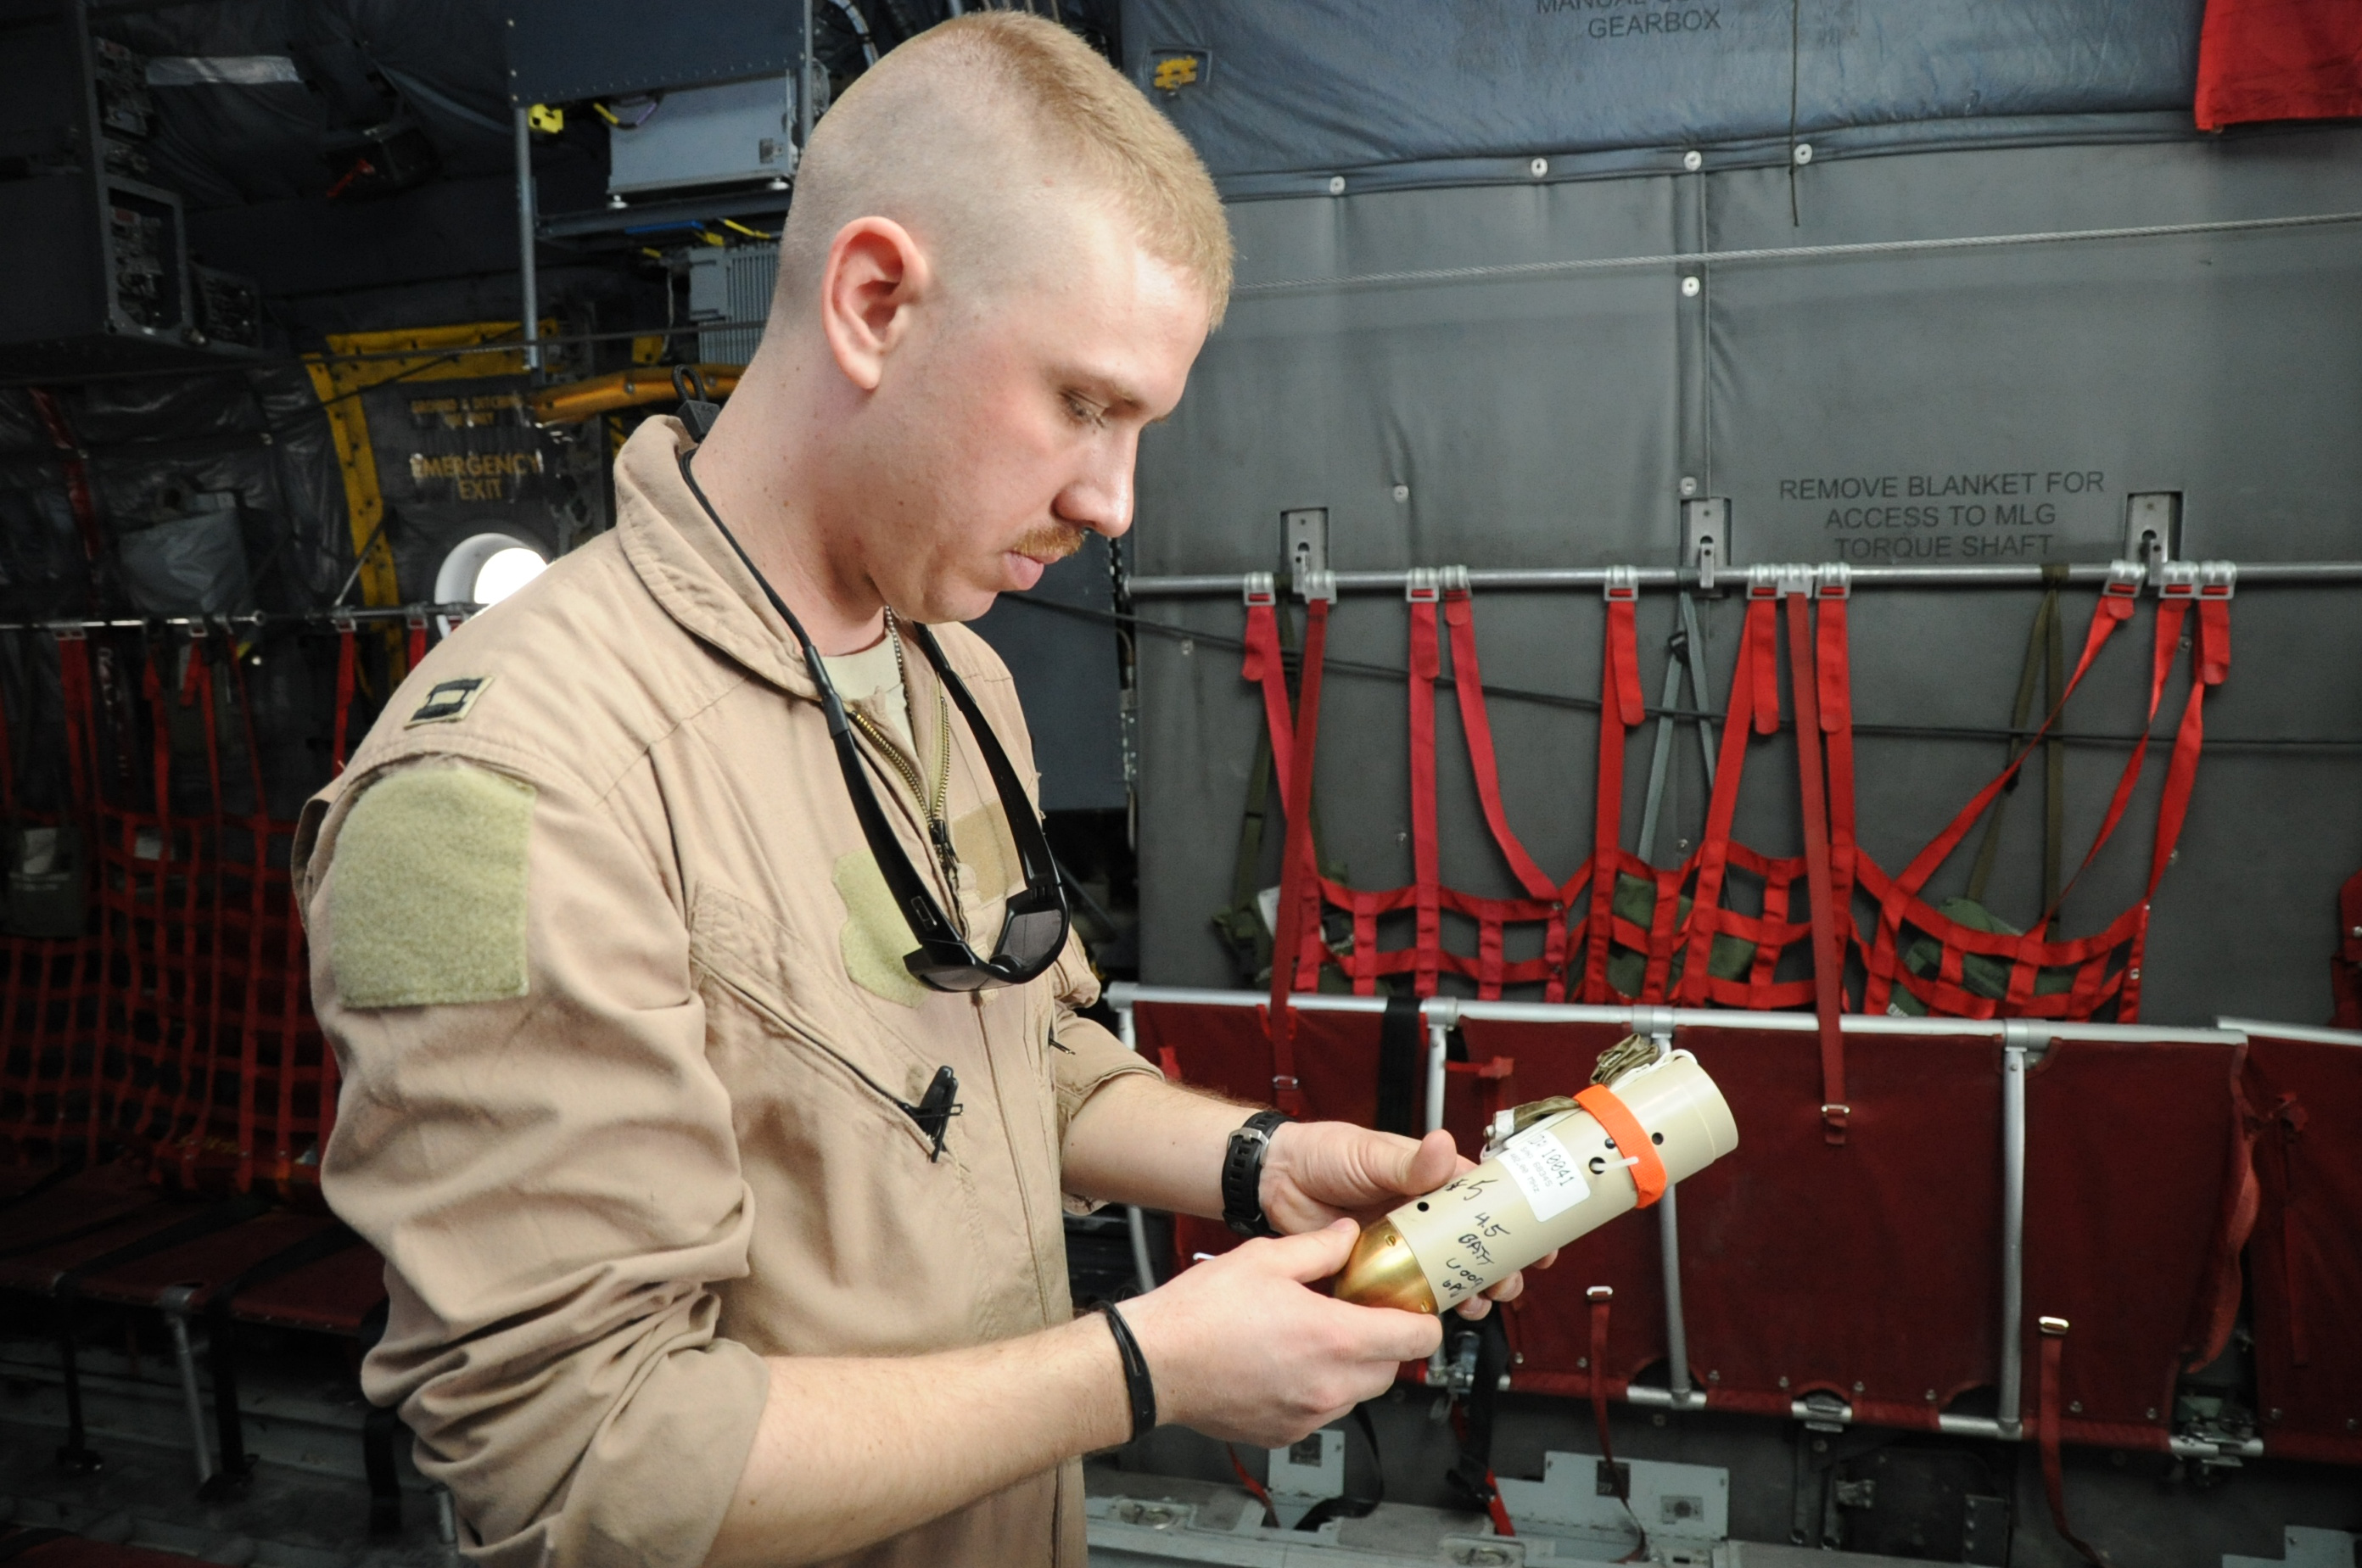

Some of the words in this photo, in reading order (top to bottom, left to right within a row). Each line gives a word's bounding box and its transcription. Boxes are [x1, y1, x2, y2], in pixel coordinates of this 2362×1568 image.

[1588, 8, 1721, 39] GEARBOX
[411, 454, 543, 478] EMERGENCY
[458, 479, 502, 500] EXIT
[1781, 476, 1898, 500] REMOVE
[1908, 473, 2036, 497] BLANKET
[2046, 471, 2104, 493] FOR
[1824, 507, 1939, 529] ACCESS
[1950, 506, 1985, 527] TO
[1995, 503, 2056, 526] MLG
[1834, 535, 1951, 559] TORQUE
[1962, 534, 2053, 557] SHAFT
[1542, 1149, 1575, 1186] 10041
[1527, 1176, 1540, 1193] MHz
[1475, 1212, 1511, 1237] 4.5
